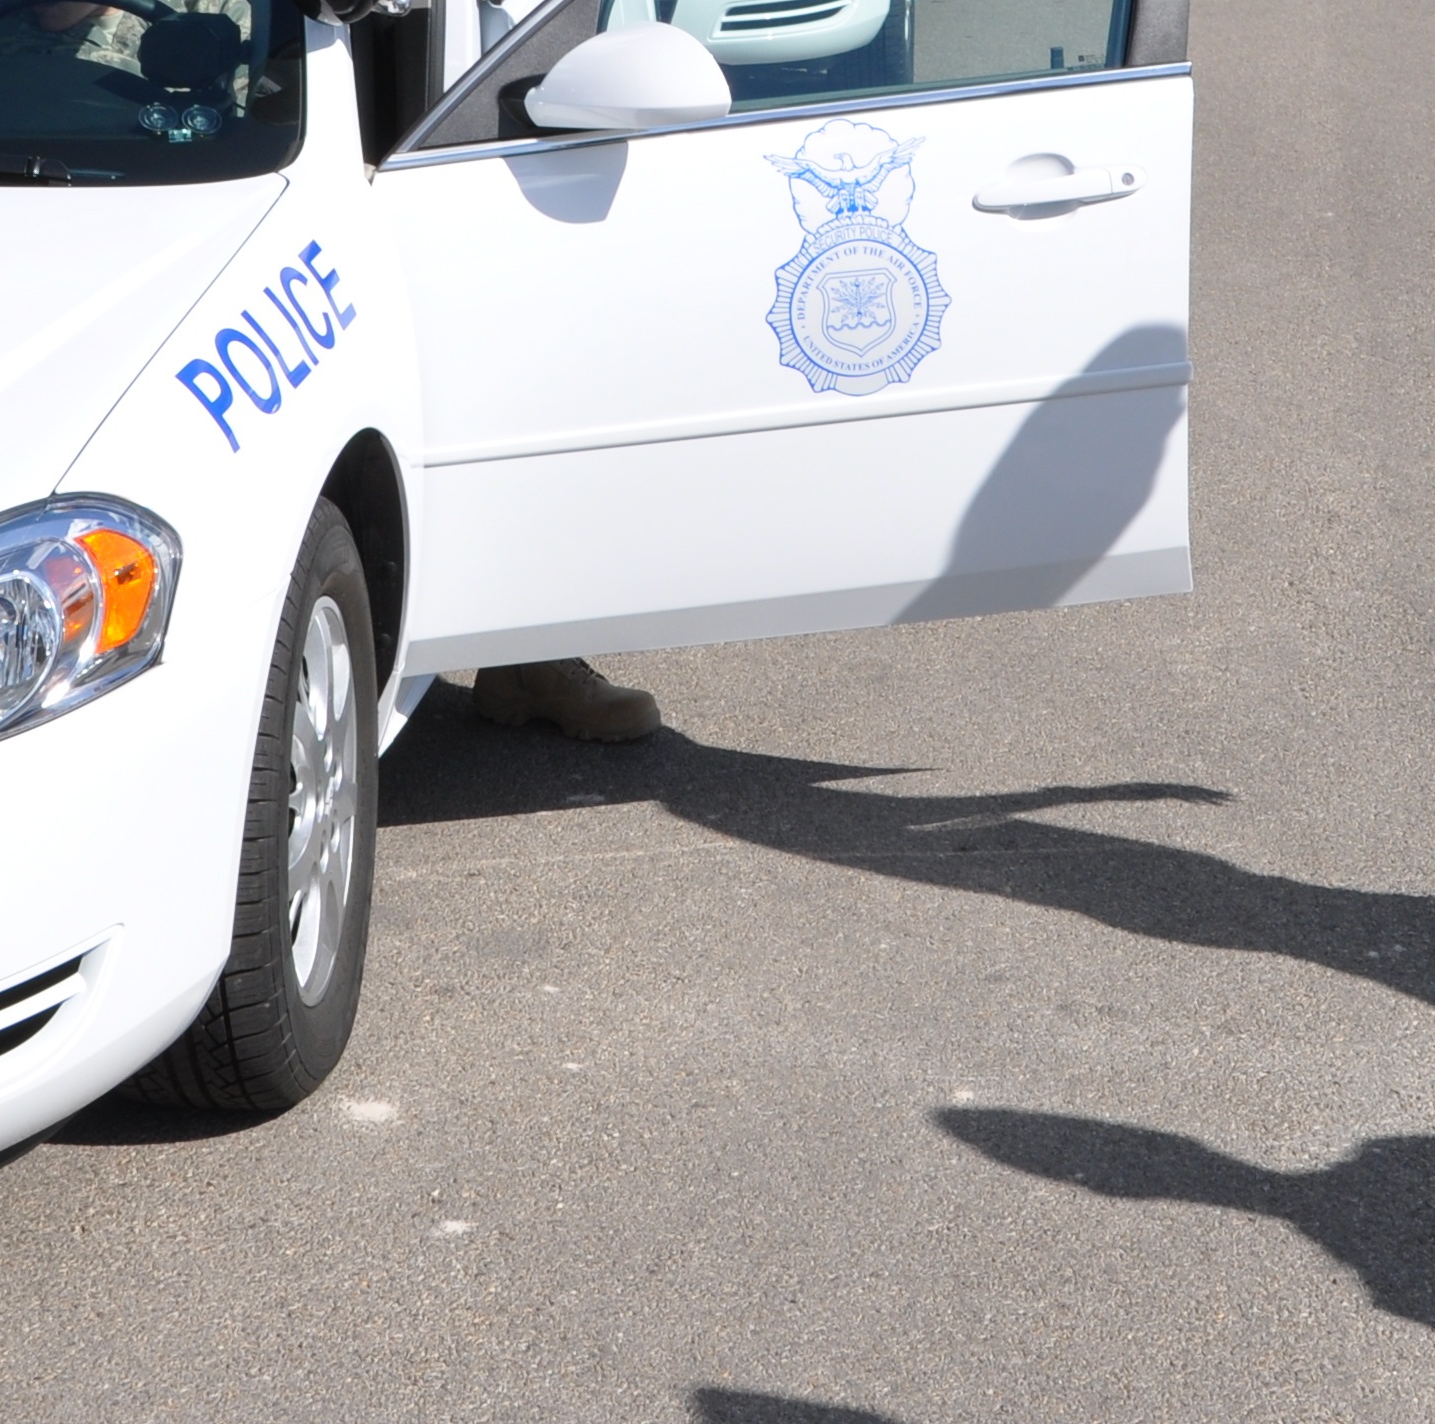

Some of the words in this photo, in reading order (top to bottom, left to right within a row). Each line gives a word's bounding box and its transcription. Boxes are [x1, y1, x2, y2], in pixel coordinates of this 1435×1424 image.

[812, 226, 857, 254] SECURITY
[859, 226, 893, 246] POLICE
[796, 251, 840, 321] DEPARTMENT
[843, 246, 858, 257] OF
[864, 246, 884, 258] THE
[886, 255, 905, 272] AIR
[903, 270, 922, 309] FORCE
[175, 239, 357, 454] POLICE
[803, 334, 833, 365] UNITED
[833, 360, 871, 372] STATES
[871, 356, 885, 368] OF
[886, 321, 921, 361] AMERICA
